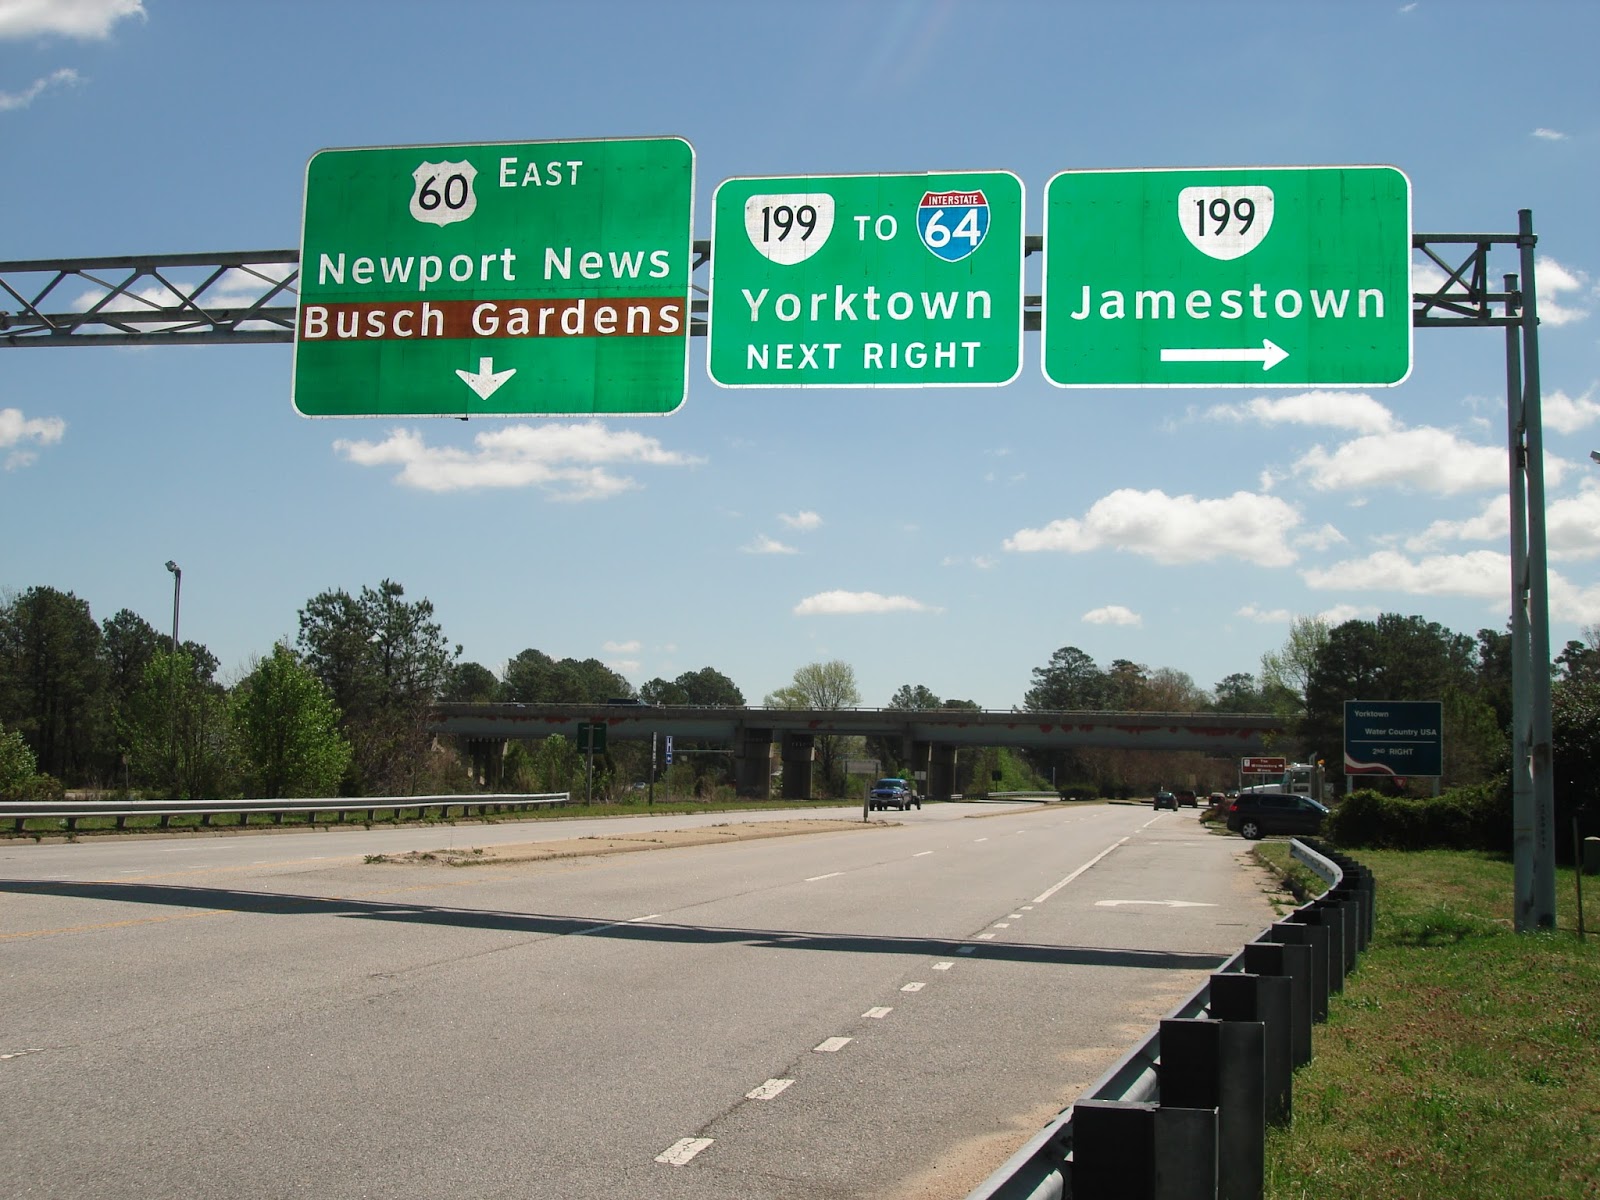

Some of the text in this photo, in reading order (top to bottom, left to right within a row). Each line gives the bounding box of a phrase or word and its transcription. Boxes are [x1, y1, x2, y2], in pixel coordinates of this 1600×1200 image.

[419, 157, 583, 210] 60 EAST
[928, 195, 979, 205] INTERSTATE
[761, 205, 981, 248] 199 TO 64
[1196, 198, 1255, 236] 199
[318, 247, 671, 291] Newport News
[304, 299, 680, 339] Busch Gardens
[741, 284, 992, 322] Yorktown
[1070, 283, 1384, 320] Jamestown
[747, 342, 982, 370] NEXT RIGHT
[1354, 710, 1389, 718] Yorktown
[1388, 728, 1418, 737] Country
